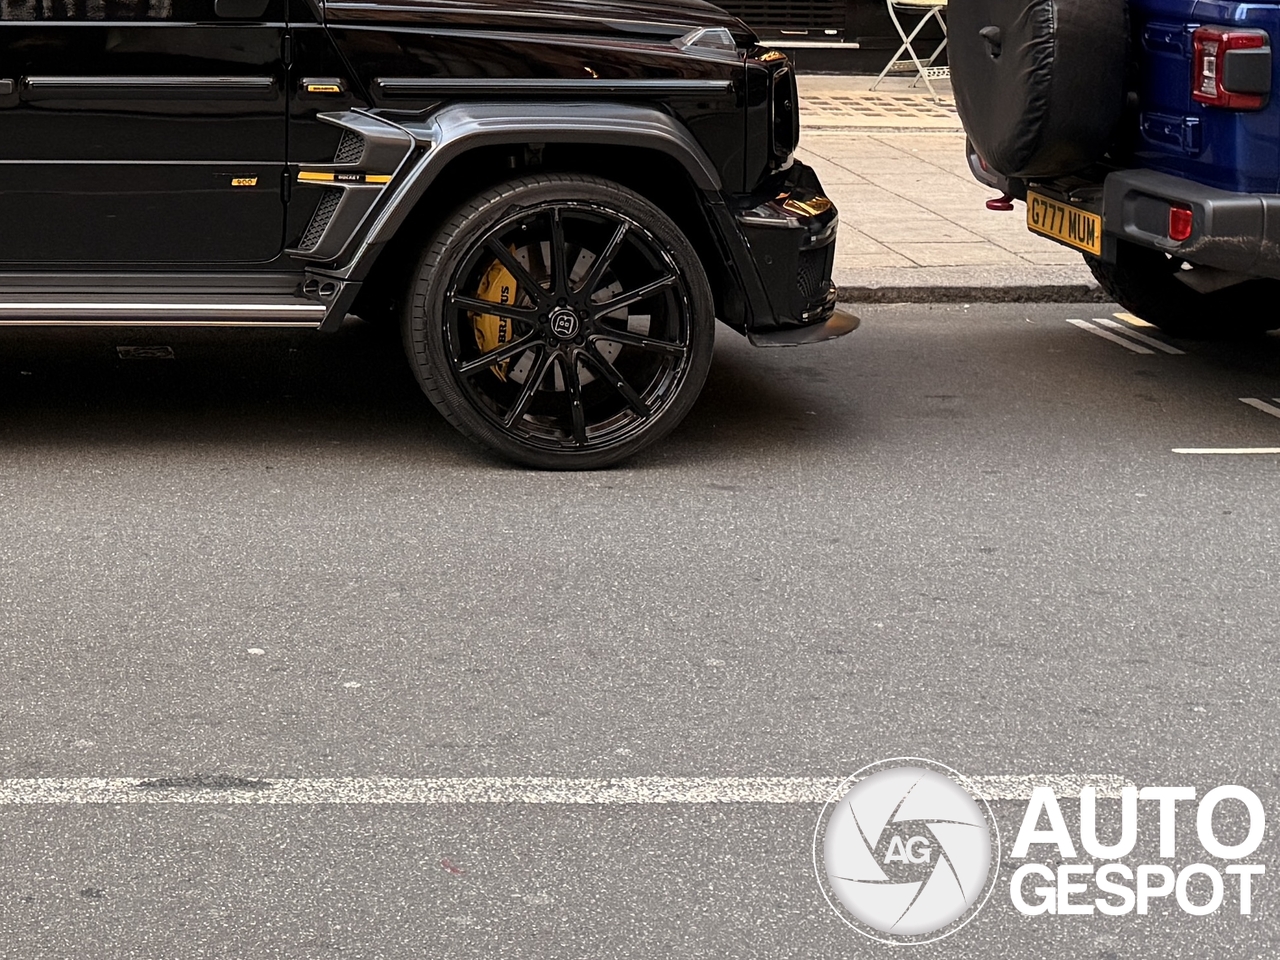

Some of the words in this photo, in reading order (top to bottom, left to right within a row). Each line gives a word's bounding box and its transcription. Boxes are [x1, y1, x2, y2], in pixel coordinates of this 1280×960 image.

[1031, 196, 1065, 235] G777
[1068, 209, 1095, 248] MUM
[498, 285, 510, 344] BRAUS
